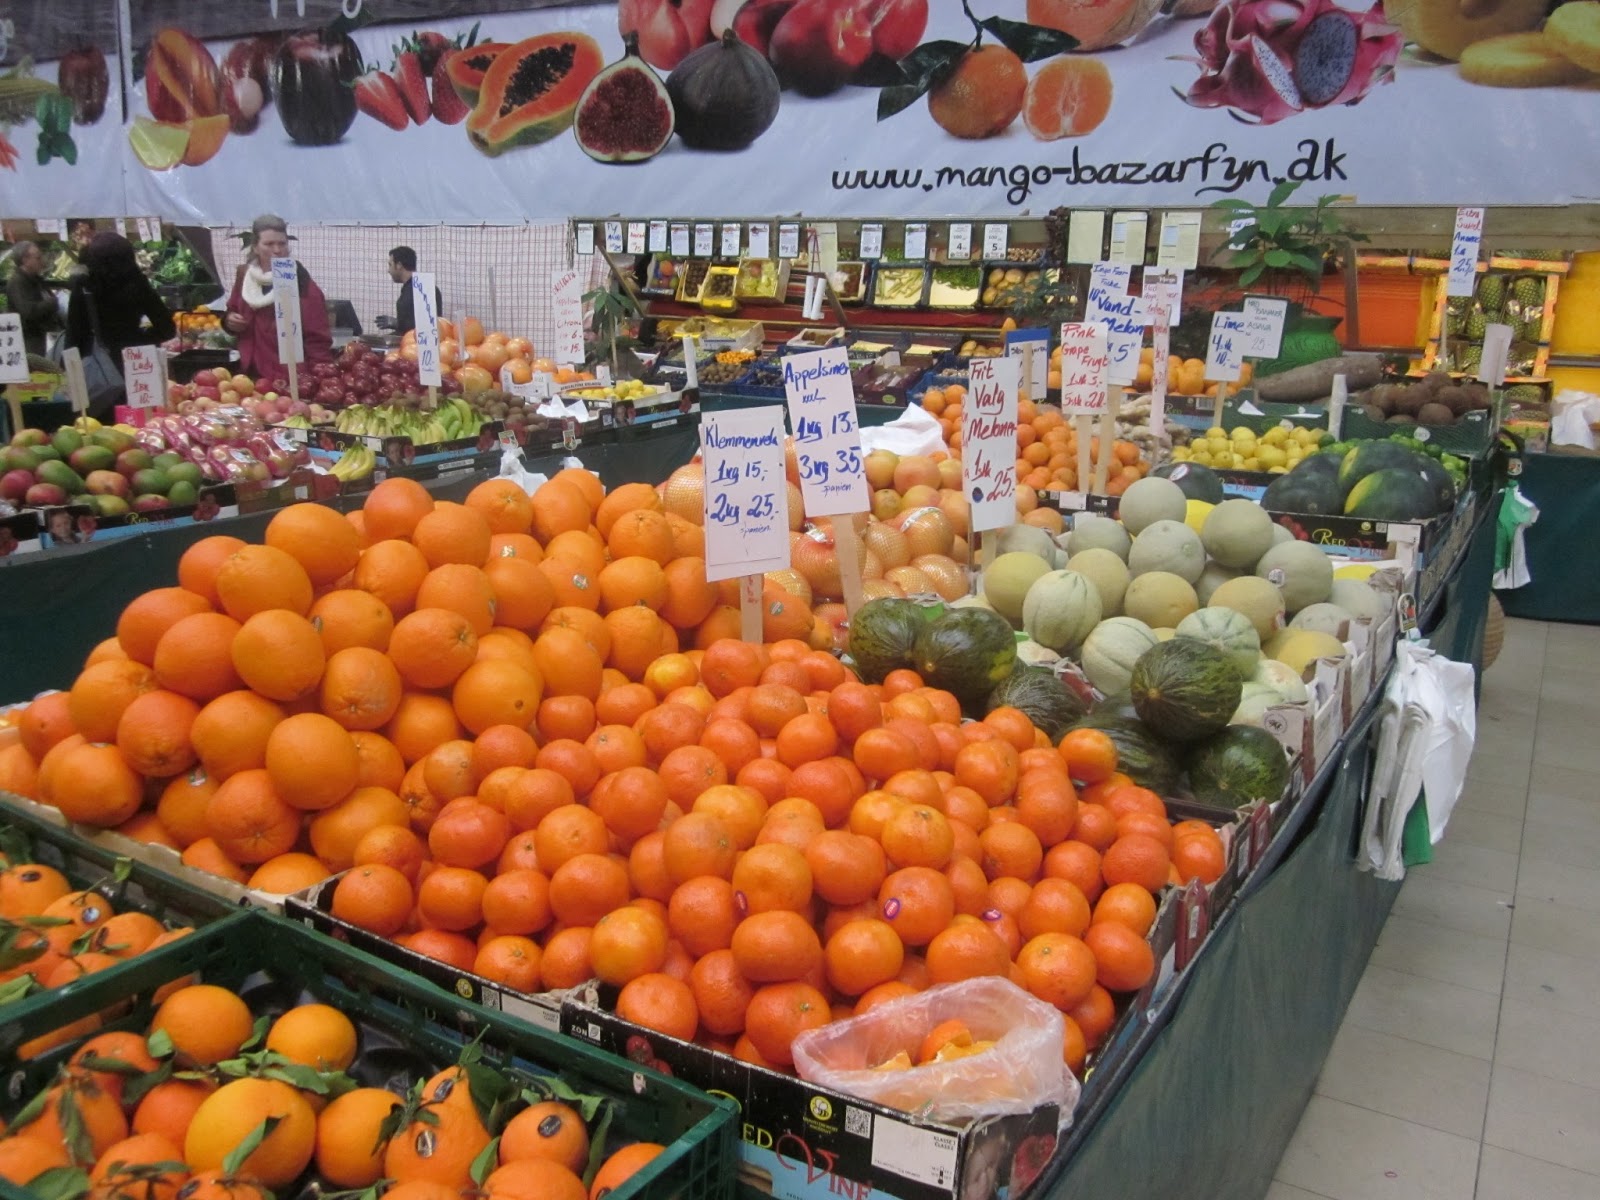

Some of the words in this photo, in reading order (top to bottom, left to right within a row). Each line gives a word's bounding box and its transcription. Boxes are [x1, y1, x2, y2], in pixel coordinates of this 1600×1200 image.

[832, 138, 1348, 205] www.mango-bazarfyn.dk
[1062, 323, 1096, 338] Pink
[1214, 315, 1244, 332] Lime
[1062, 342, 1089, 359] Grape
[132, 357, 153, 375] Lady
[970, 359, 994, 380] Frit
[975, 382, 1005, 416] Valg
[1312, 528, 1346, 546] RED
[571, 1025, 588, 1037] ZON
[742, 1122, 773, 1148] ED
